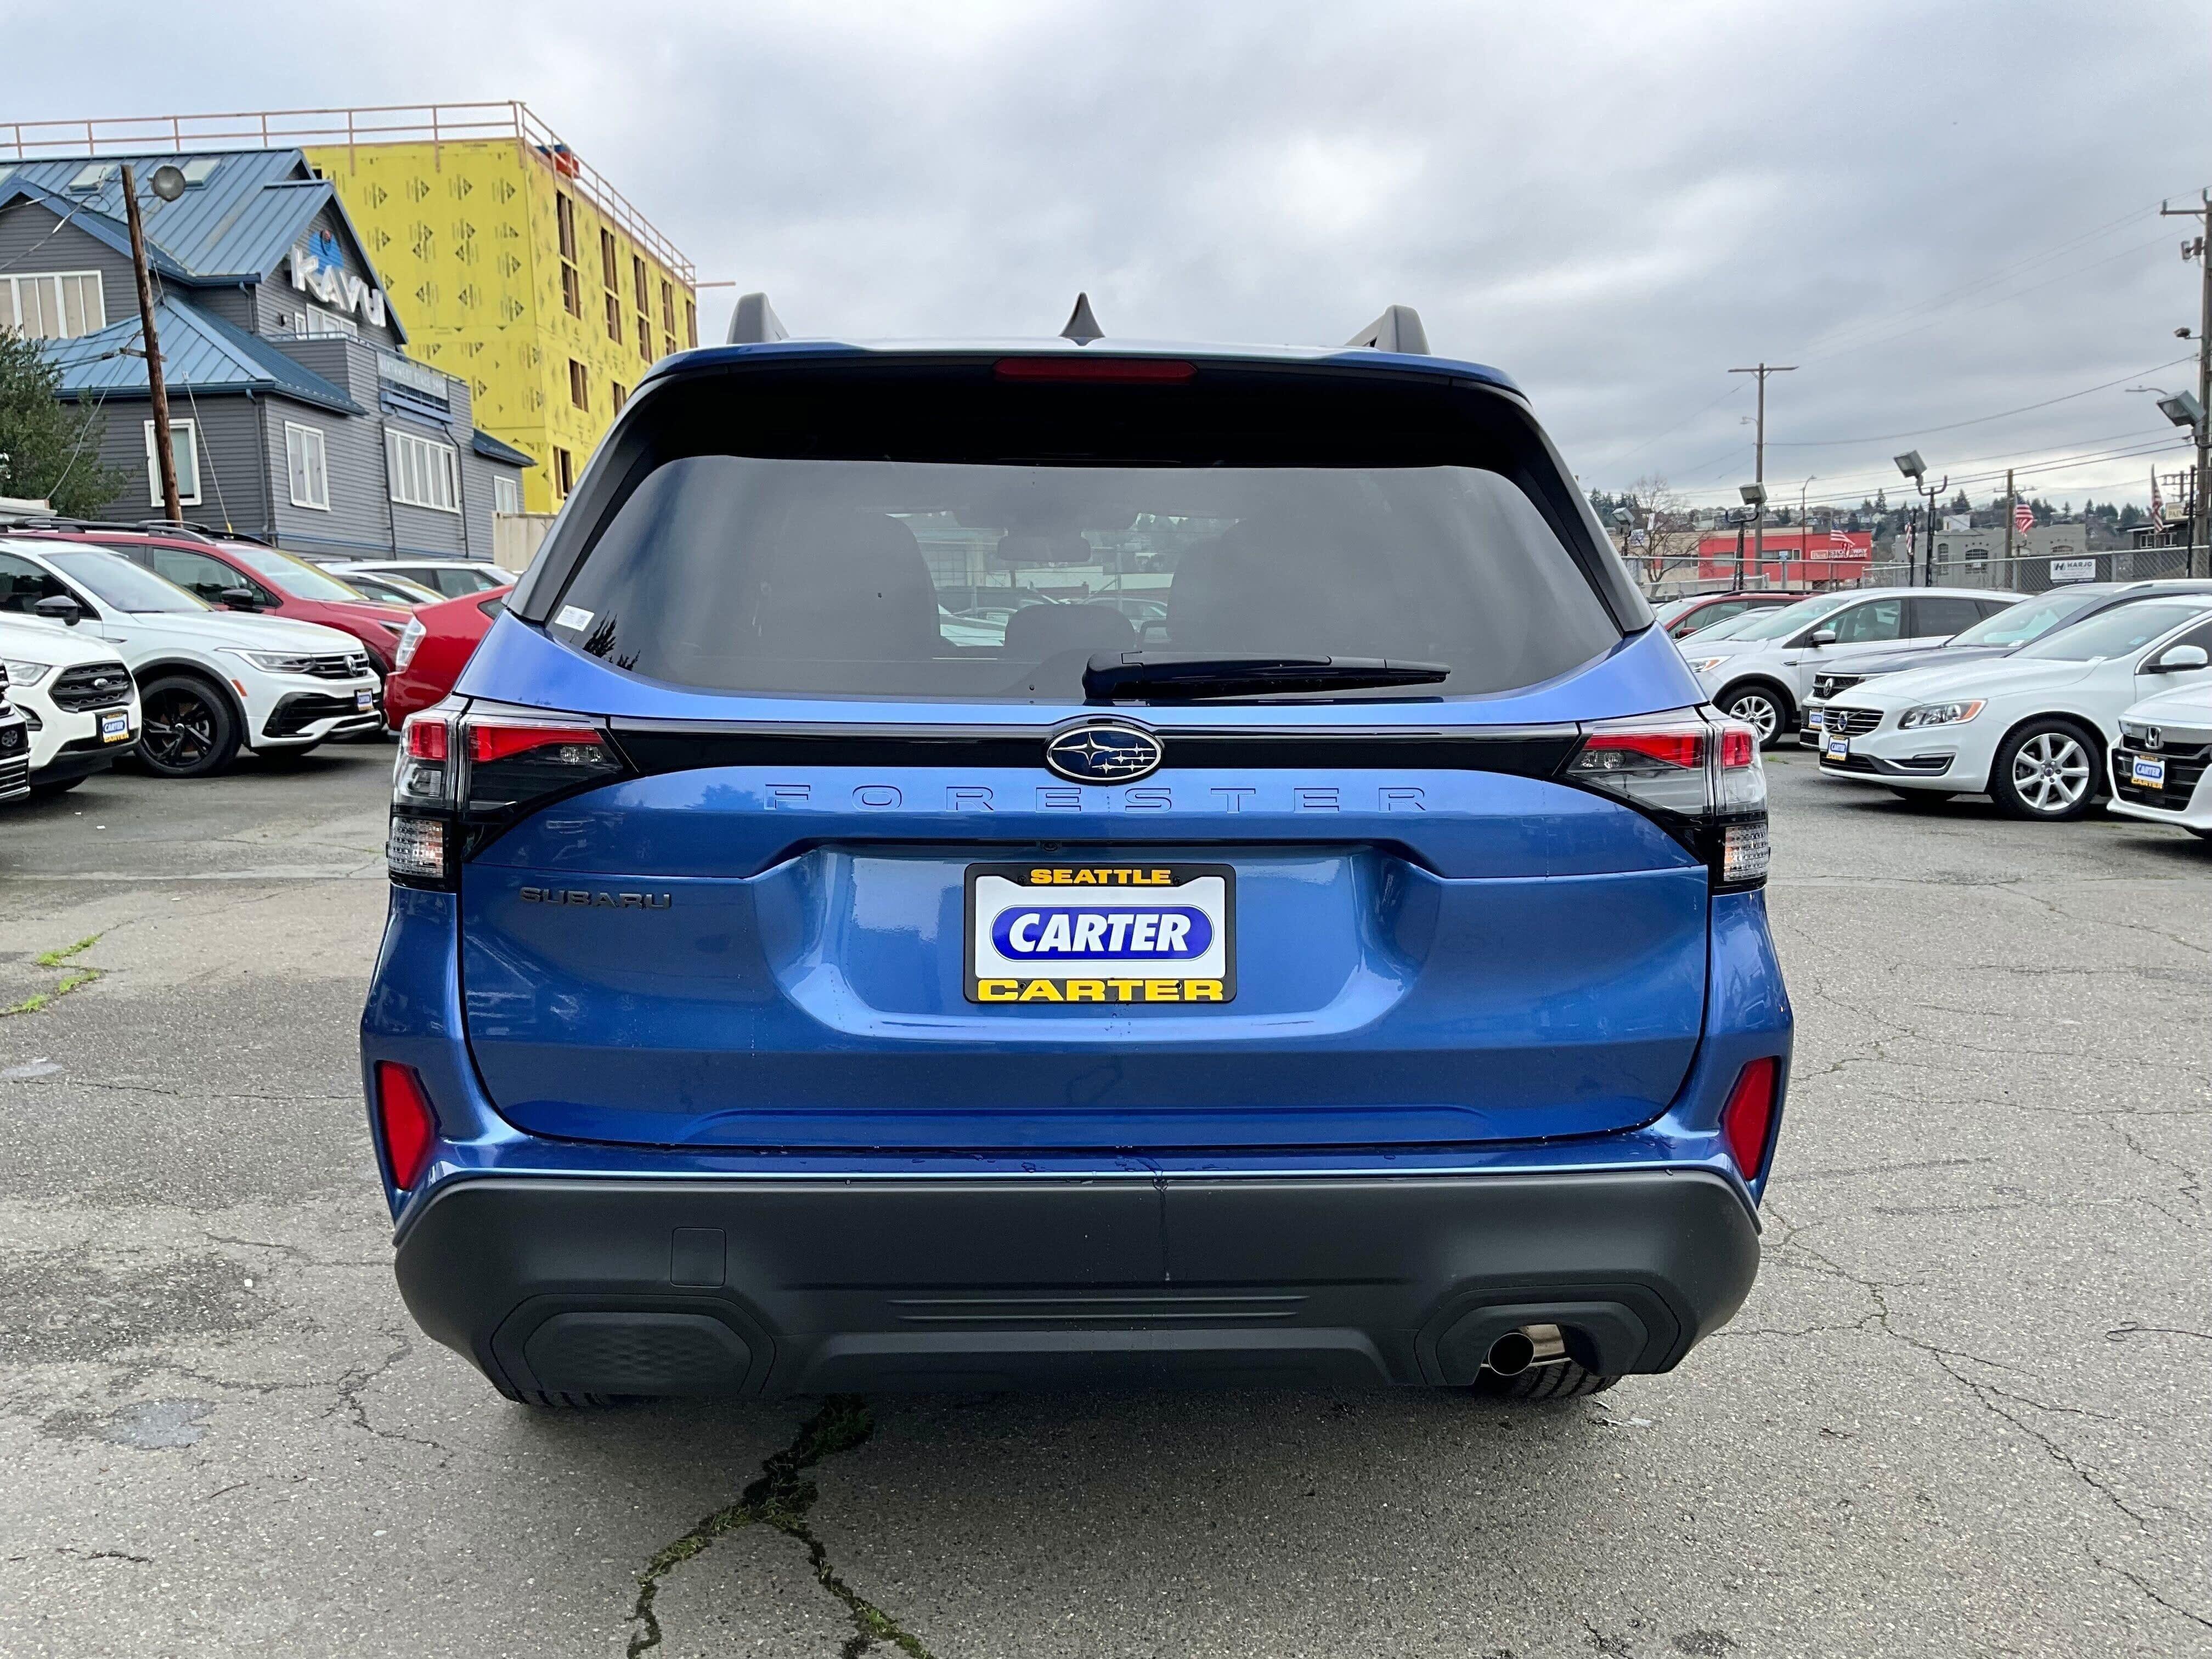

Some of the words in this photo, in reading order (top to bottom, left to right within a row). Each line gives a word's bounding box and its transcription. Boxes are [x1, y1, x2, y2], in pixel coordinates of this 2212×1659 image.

[290, 244, 386, 328] KAVU
[105, 721, 123, 732] CARTER
[1831, 743, 1846, 752] CARTER
[2136, 764, 2160, 777] CARTER
[764, 783, 1426, 813] FORESTER
[1030, 869, 1171, 884] SEATTLE
[521, 887, 671, 910] SUBARU
[1009, 913, 1191, 952] CARTER
[978, 979, 1223, 1002] CARTER
